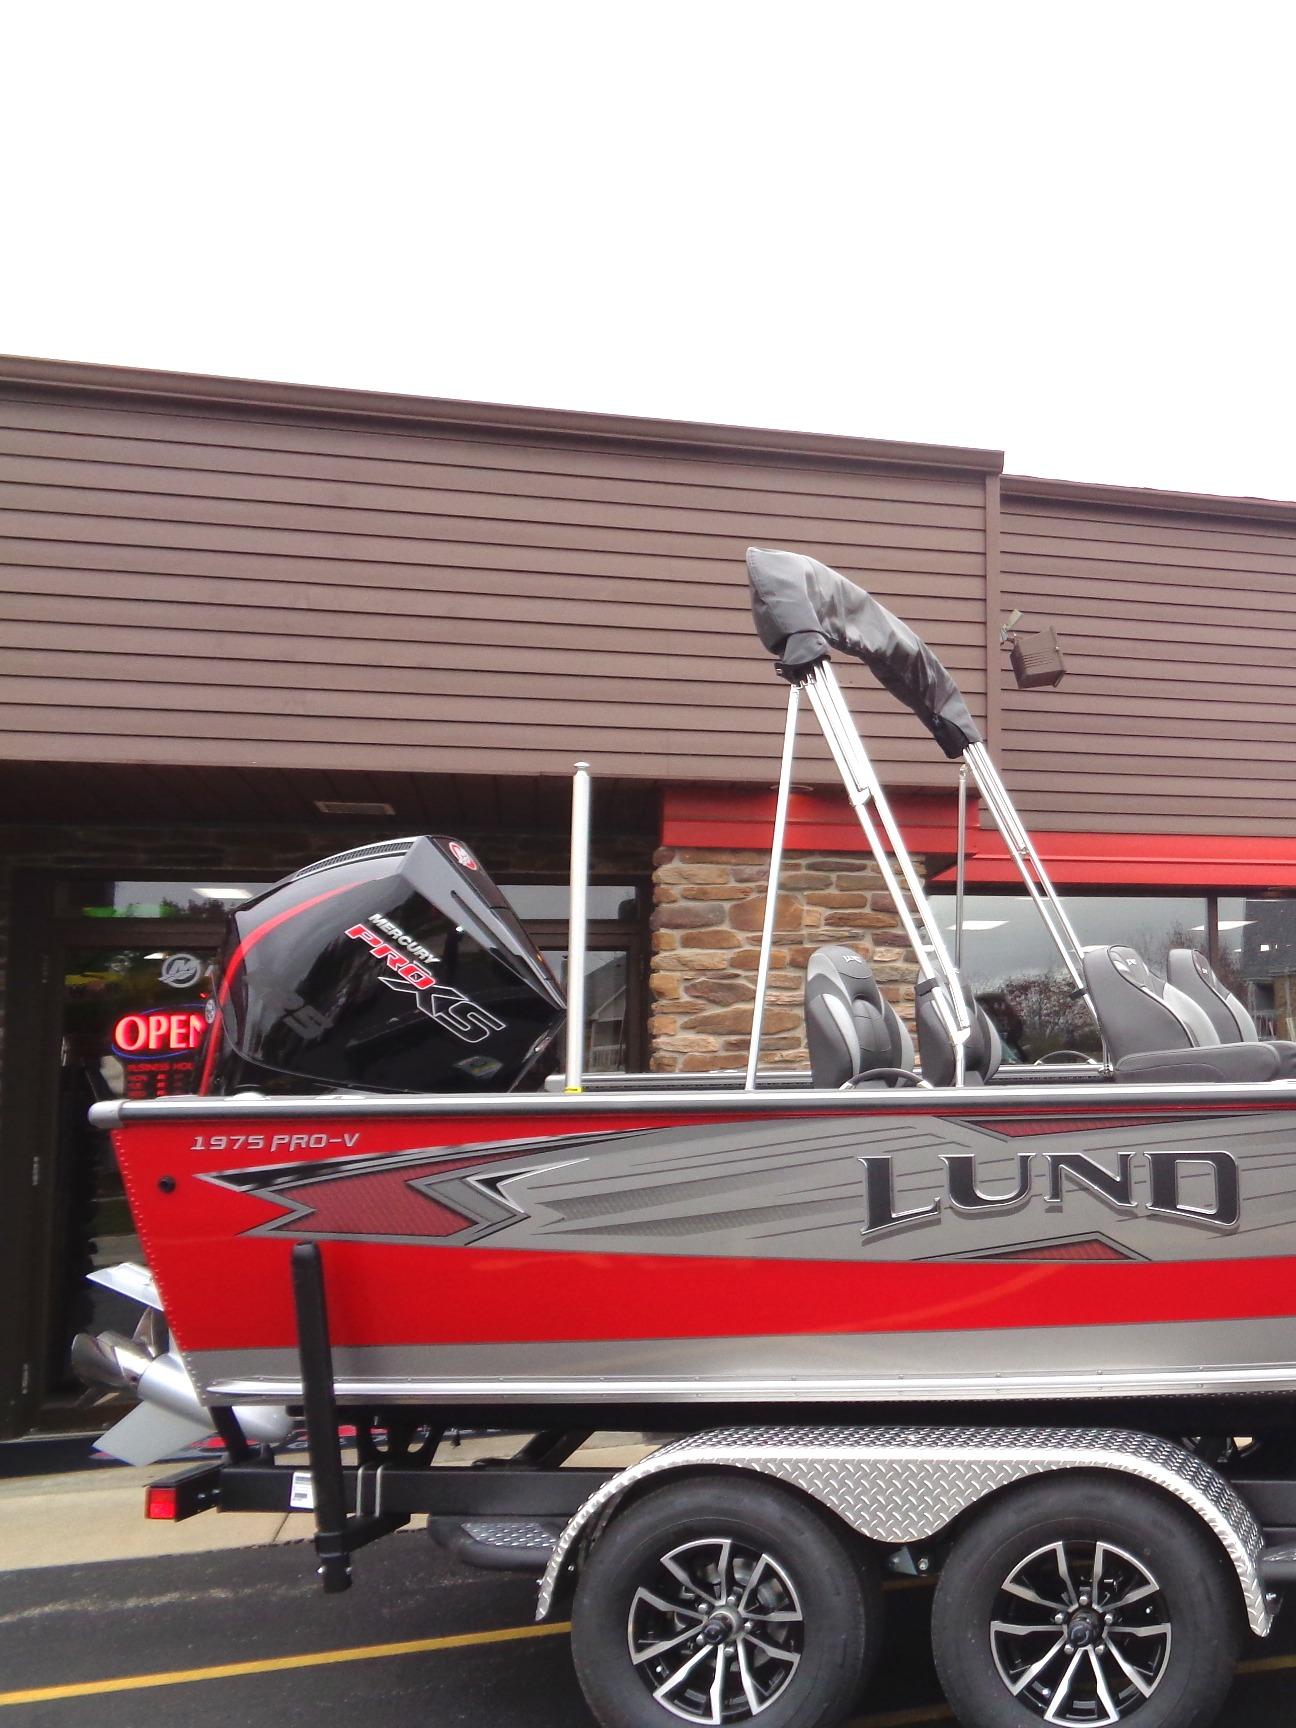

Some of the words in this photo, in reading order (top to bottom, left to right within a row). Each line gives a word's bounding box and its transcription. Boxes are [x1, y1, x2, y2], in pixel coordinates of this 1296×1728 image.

[344, 923, 436, 990] PRO
[368, 913, 441, 964] MERCURY
[377, 976, 507, 1043] XS
[190, 1135, 265, 1150] 1975
[270, 1133, 359, 1152] PRO-V
[857, 1151, 1240, 1236] LUND
